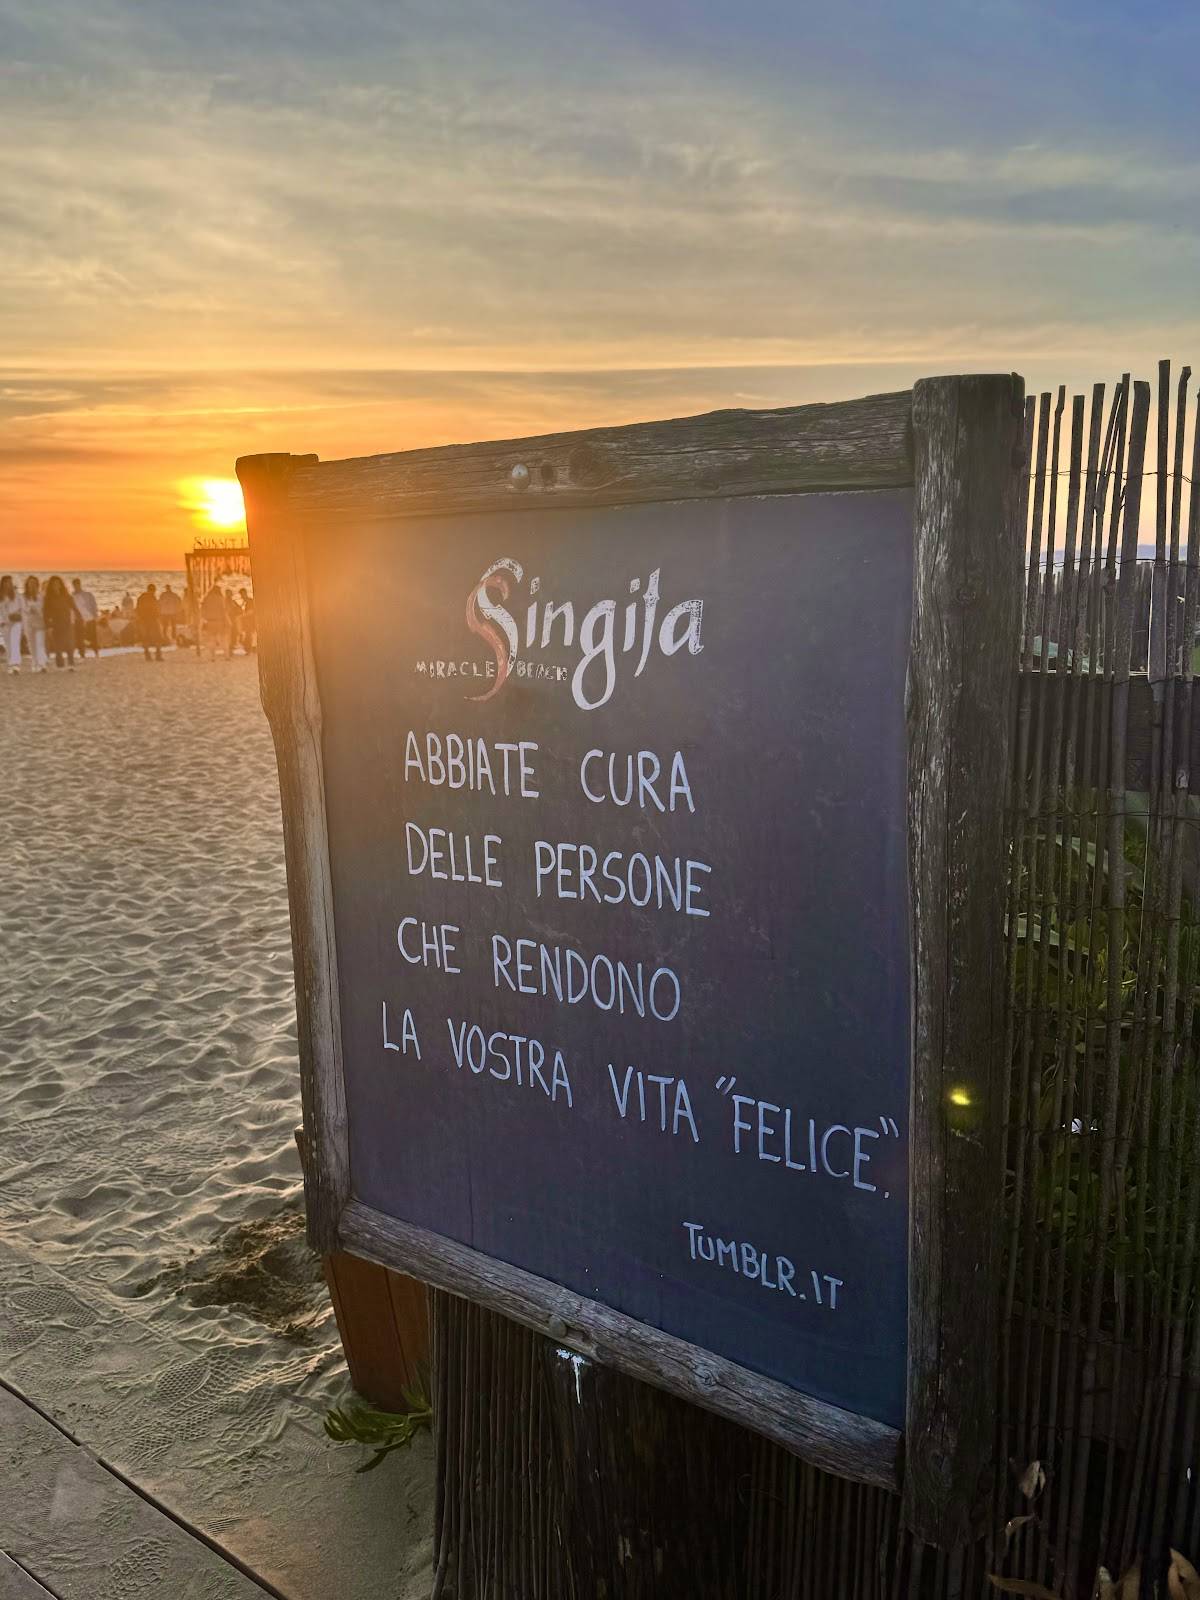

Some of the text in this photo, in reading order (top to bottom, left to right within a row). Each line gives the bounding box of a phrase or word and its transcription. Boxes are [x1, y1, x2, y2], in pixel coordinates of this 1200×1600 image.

[415, 660, 495, 678] MIRACLE
[464, 557, 704, 710] Singita
[405, 731, 696, 813] ABBIATE CURA
[405, 822, 712, 916] DELLE PERSONE
[397, 917, 681, 1021] CHE RENDONO
[382, 1001, 422, 1061] LA
[447, 1017, 573, 1108] VOSTRA
[608, 1063, 700, 1143] VITA
